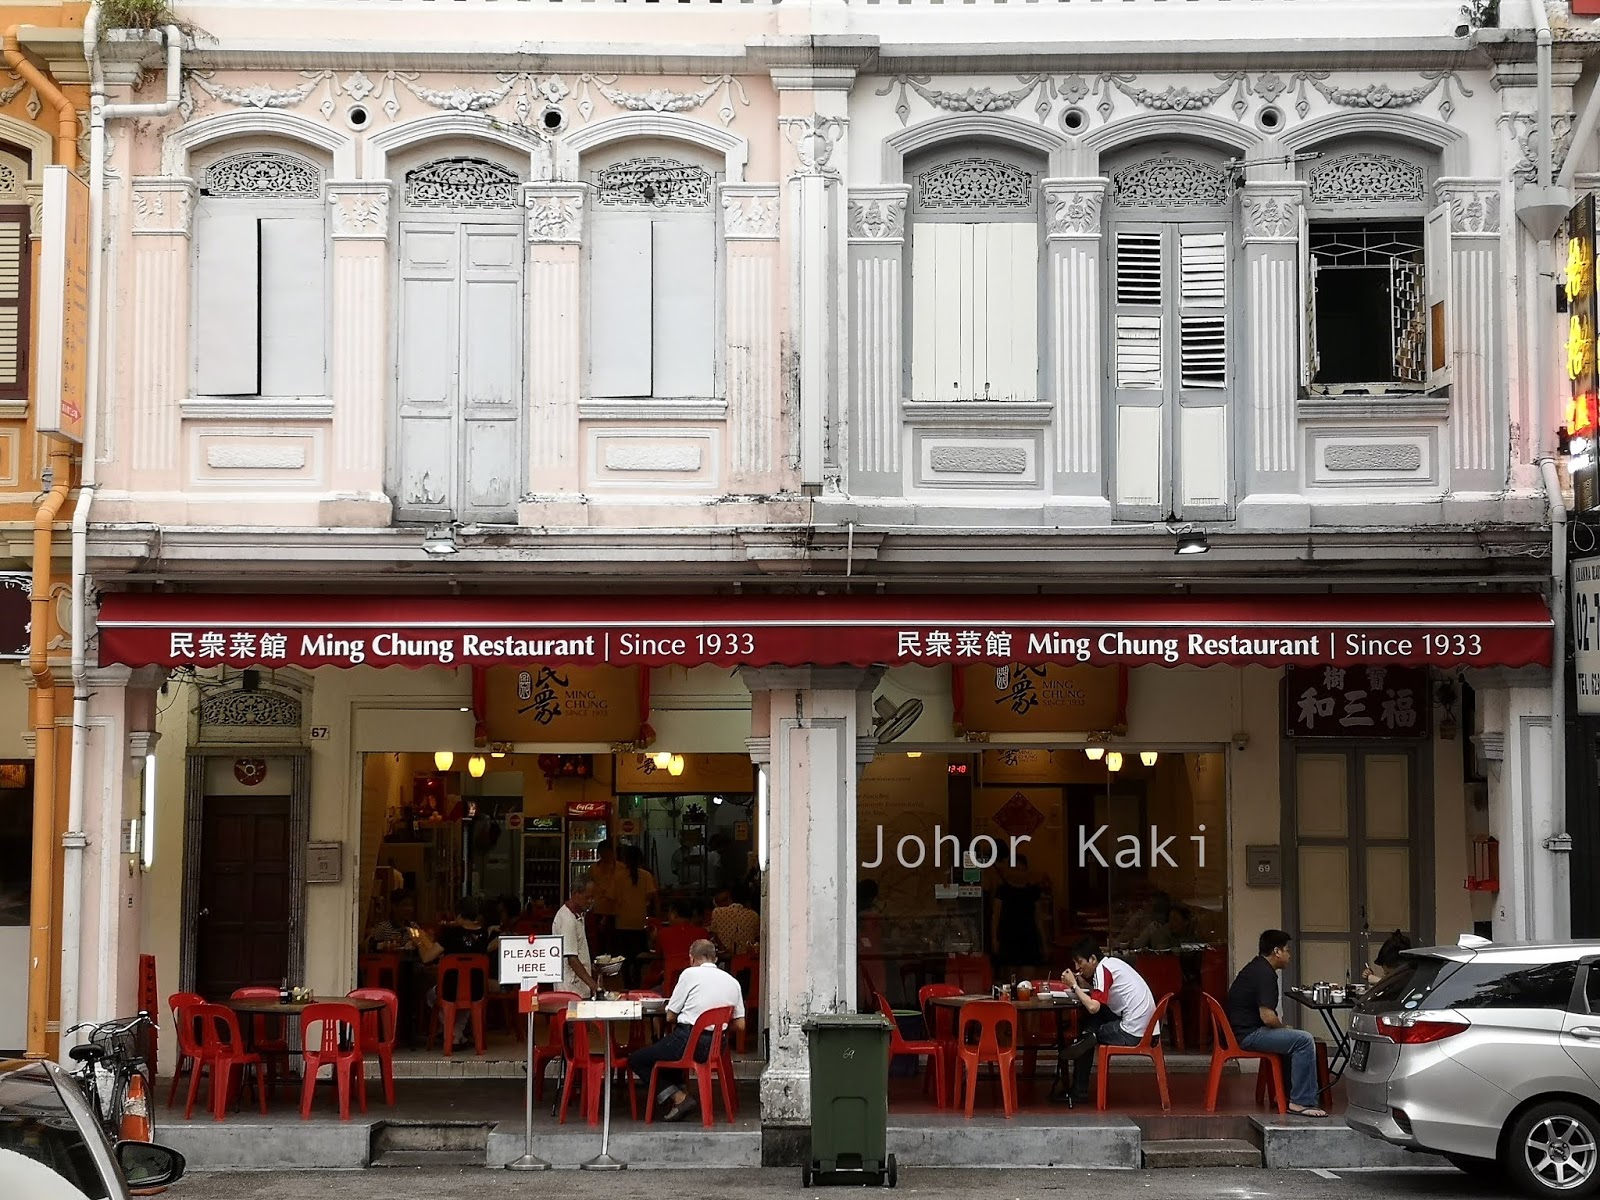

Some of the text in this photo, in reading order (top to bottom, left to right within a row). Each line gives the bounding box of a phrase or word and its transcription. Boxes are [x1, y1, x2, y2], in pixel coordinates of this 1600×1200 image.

[169, 631, 287, 659] 民衆菜館
[301, 633, 364, 663] Ming
[372, 633, 454, 663] Chung
[463, 634, 594, 656] Restaurant
[619, 633, 685, 656] Since
[696, 633, 755, 656] 1933
[897, 630, 1012, 657] 民衆菜館
[1028, 632, 1090, 662] Ming
[1098, 632, 1178, 662] Chung
[1189, 634, 1319, 656] Restaurant
[1346, 633, 1412, 656] Since
[1422, 634, 1482, 656] 1933
[1042, 680, 1074, 689] MING
[565, 690, 596, 699] MING
[1042, 689, 1085, 699] CHUNG
[565, 699, 608, 709] CHUNG
[312, 727, 327, 738] 67
[1258, 864, 1271, 873] 69
[503, 946, 560, 959] PLEASE Q
[517, 963, 546, 972] HERE
[843, 1047, 855, 1059] 69
